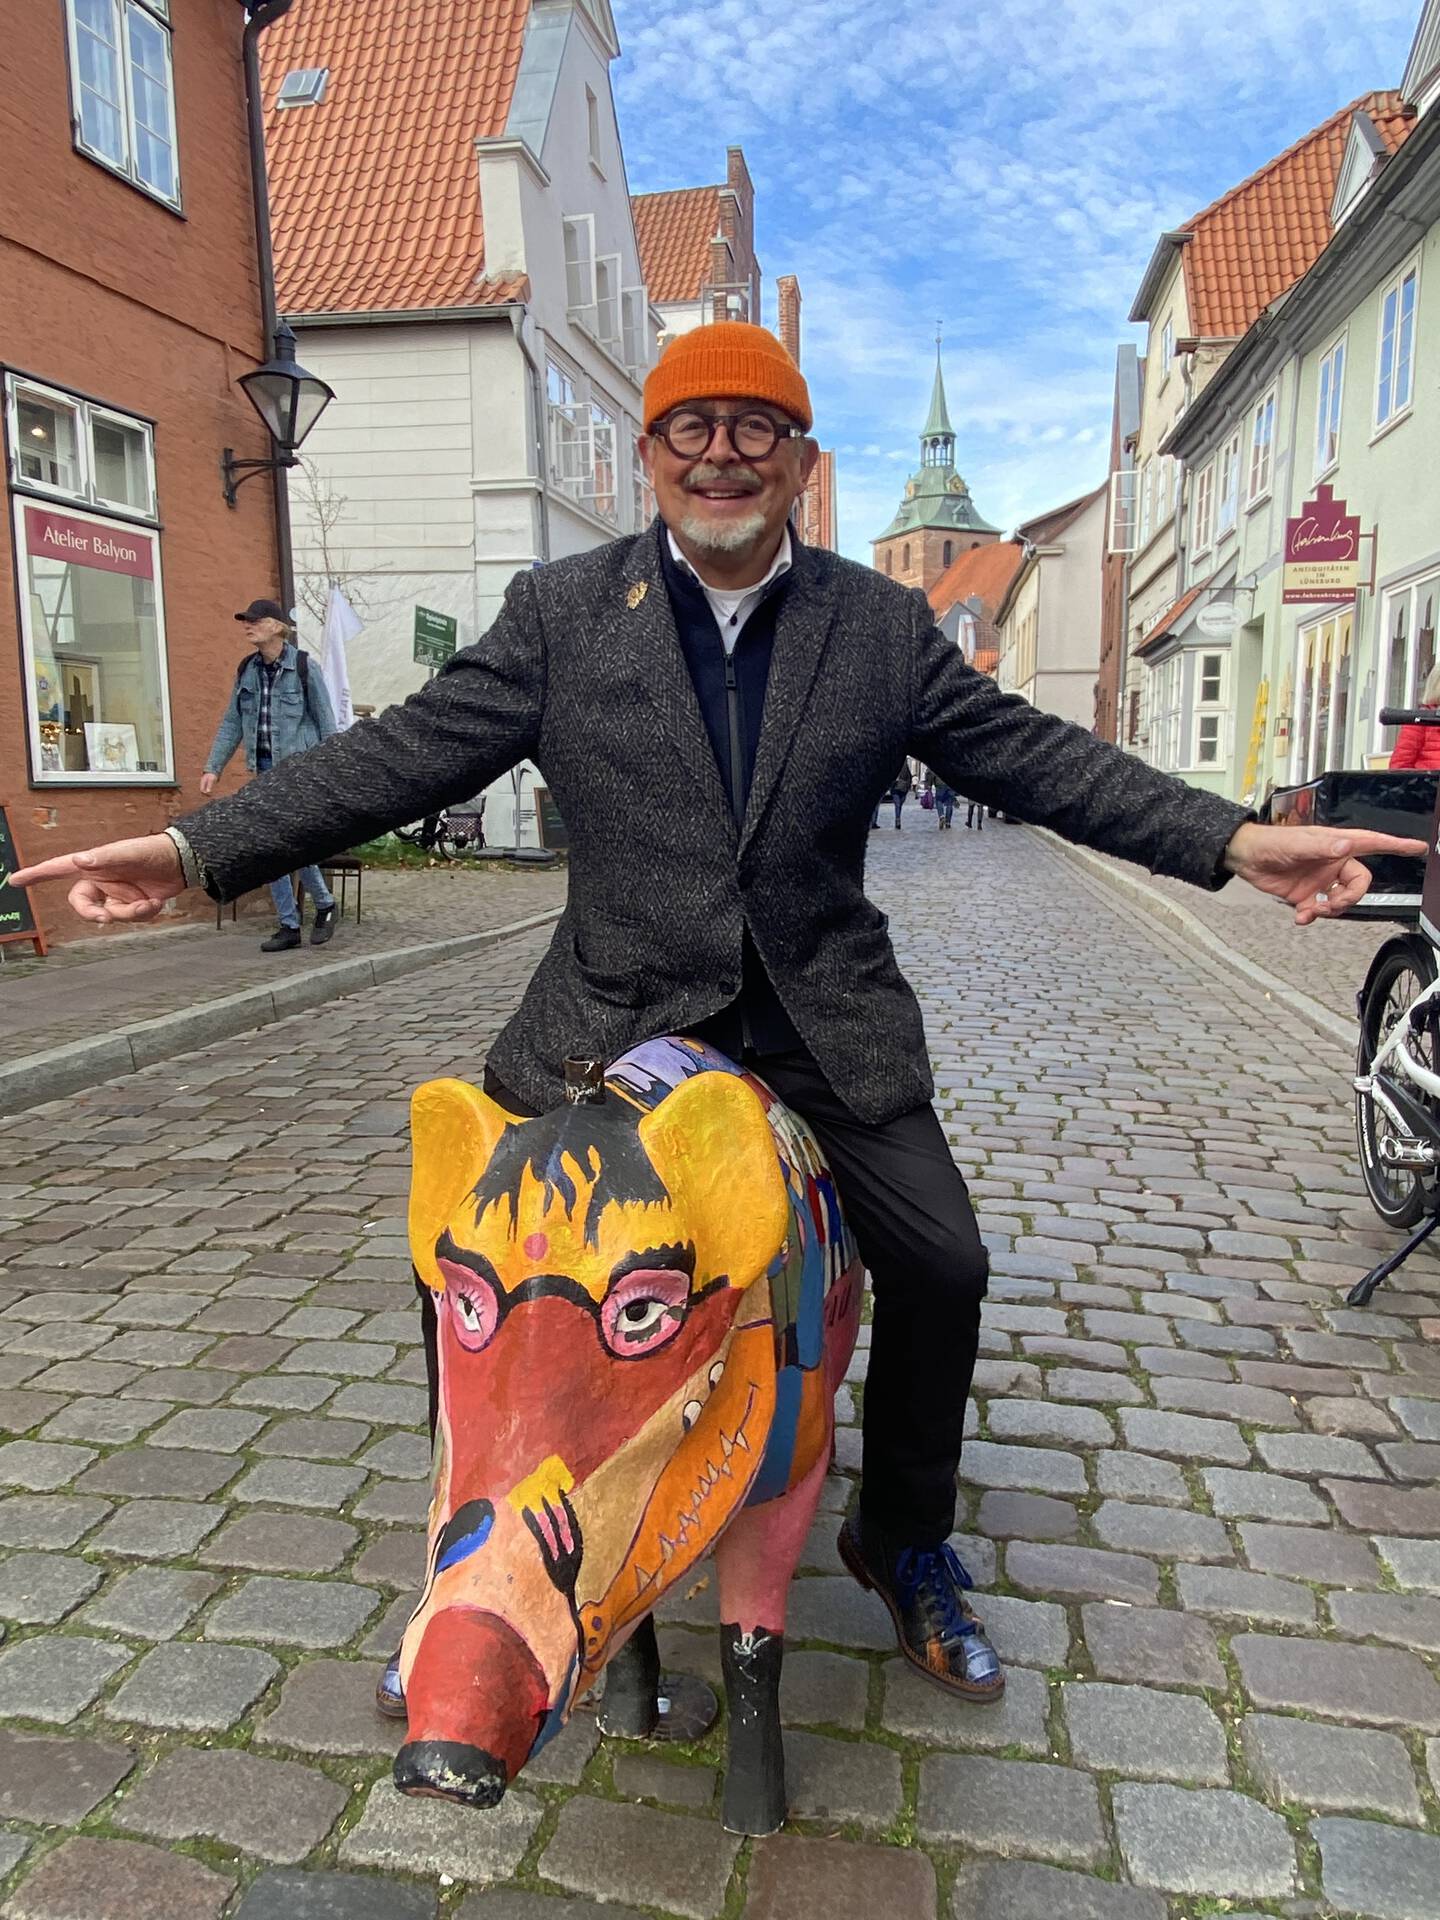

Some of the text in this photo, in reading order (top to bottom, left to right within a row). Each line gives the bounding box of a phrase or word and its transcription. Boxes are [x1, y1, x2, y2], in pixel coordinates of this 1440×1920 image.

[43, 525, 137, 563] Atelier Balyon
[1292, 565, 1350, 573] ANTIQUITÄTEN
